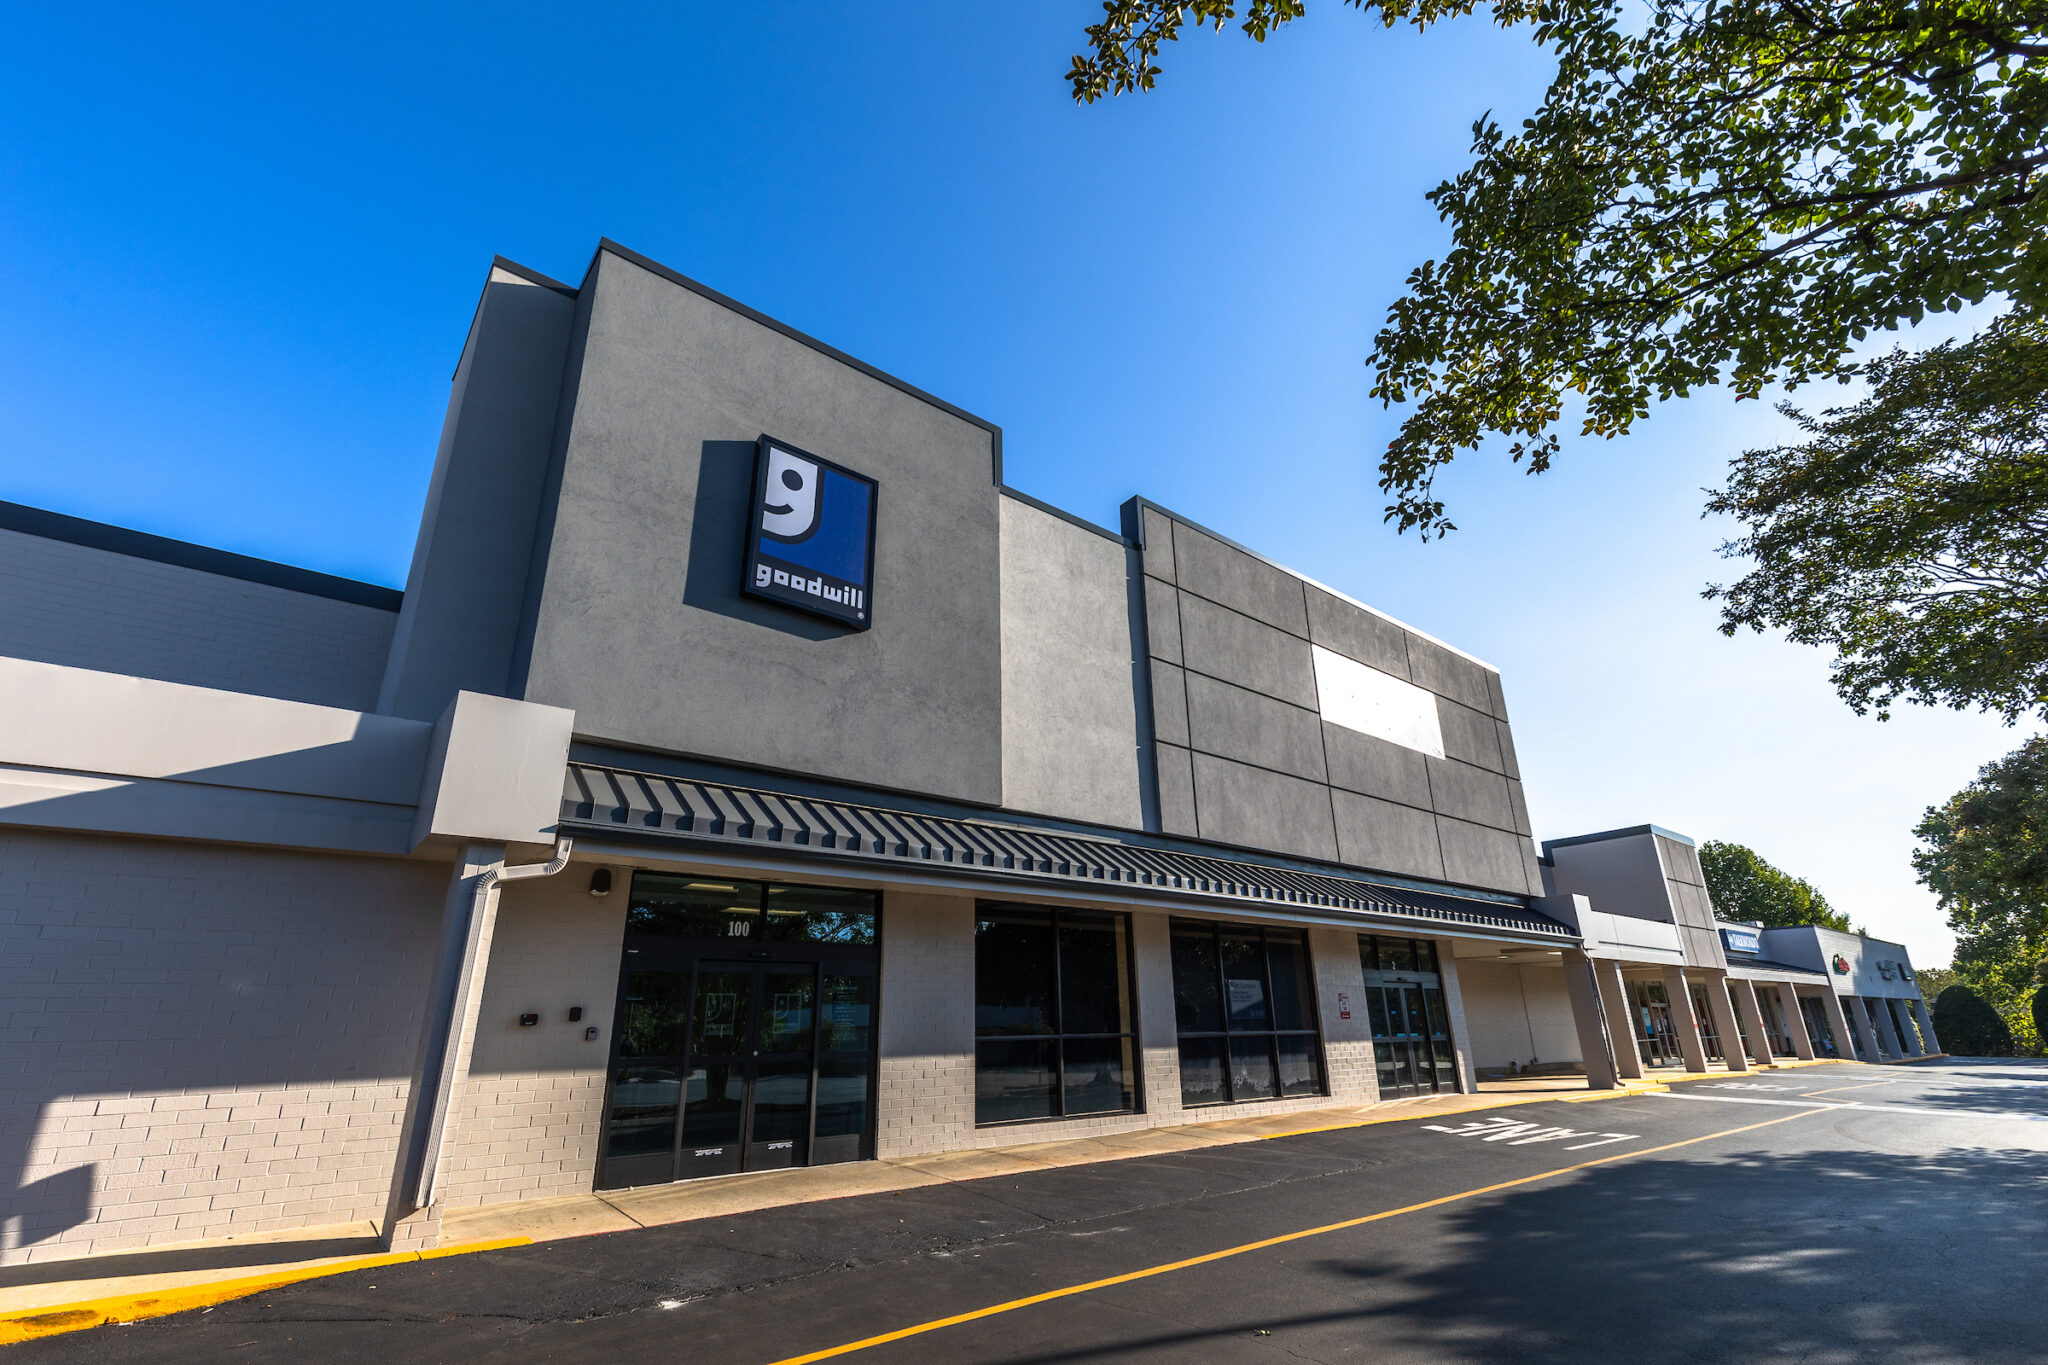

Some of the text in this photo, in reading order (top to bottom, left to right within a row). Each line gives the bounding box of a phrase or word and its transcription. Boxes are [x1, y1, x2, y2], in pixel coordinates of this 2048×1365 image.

[755, 563, 863, 609] goodwill
[727, 920, 750, 937] 100
[1420, 1117, 1642, 1151] LANE
